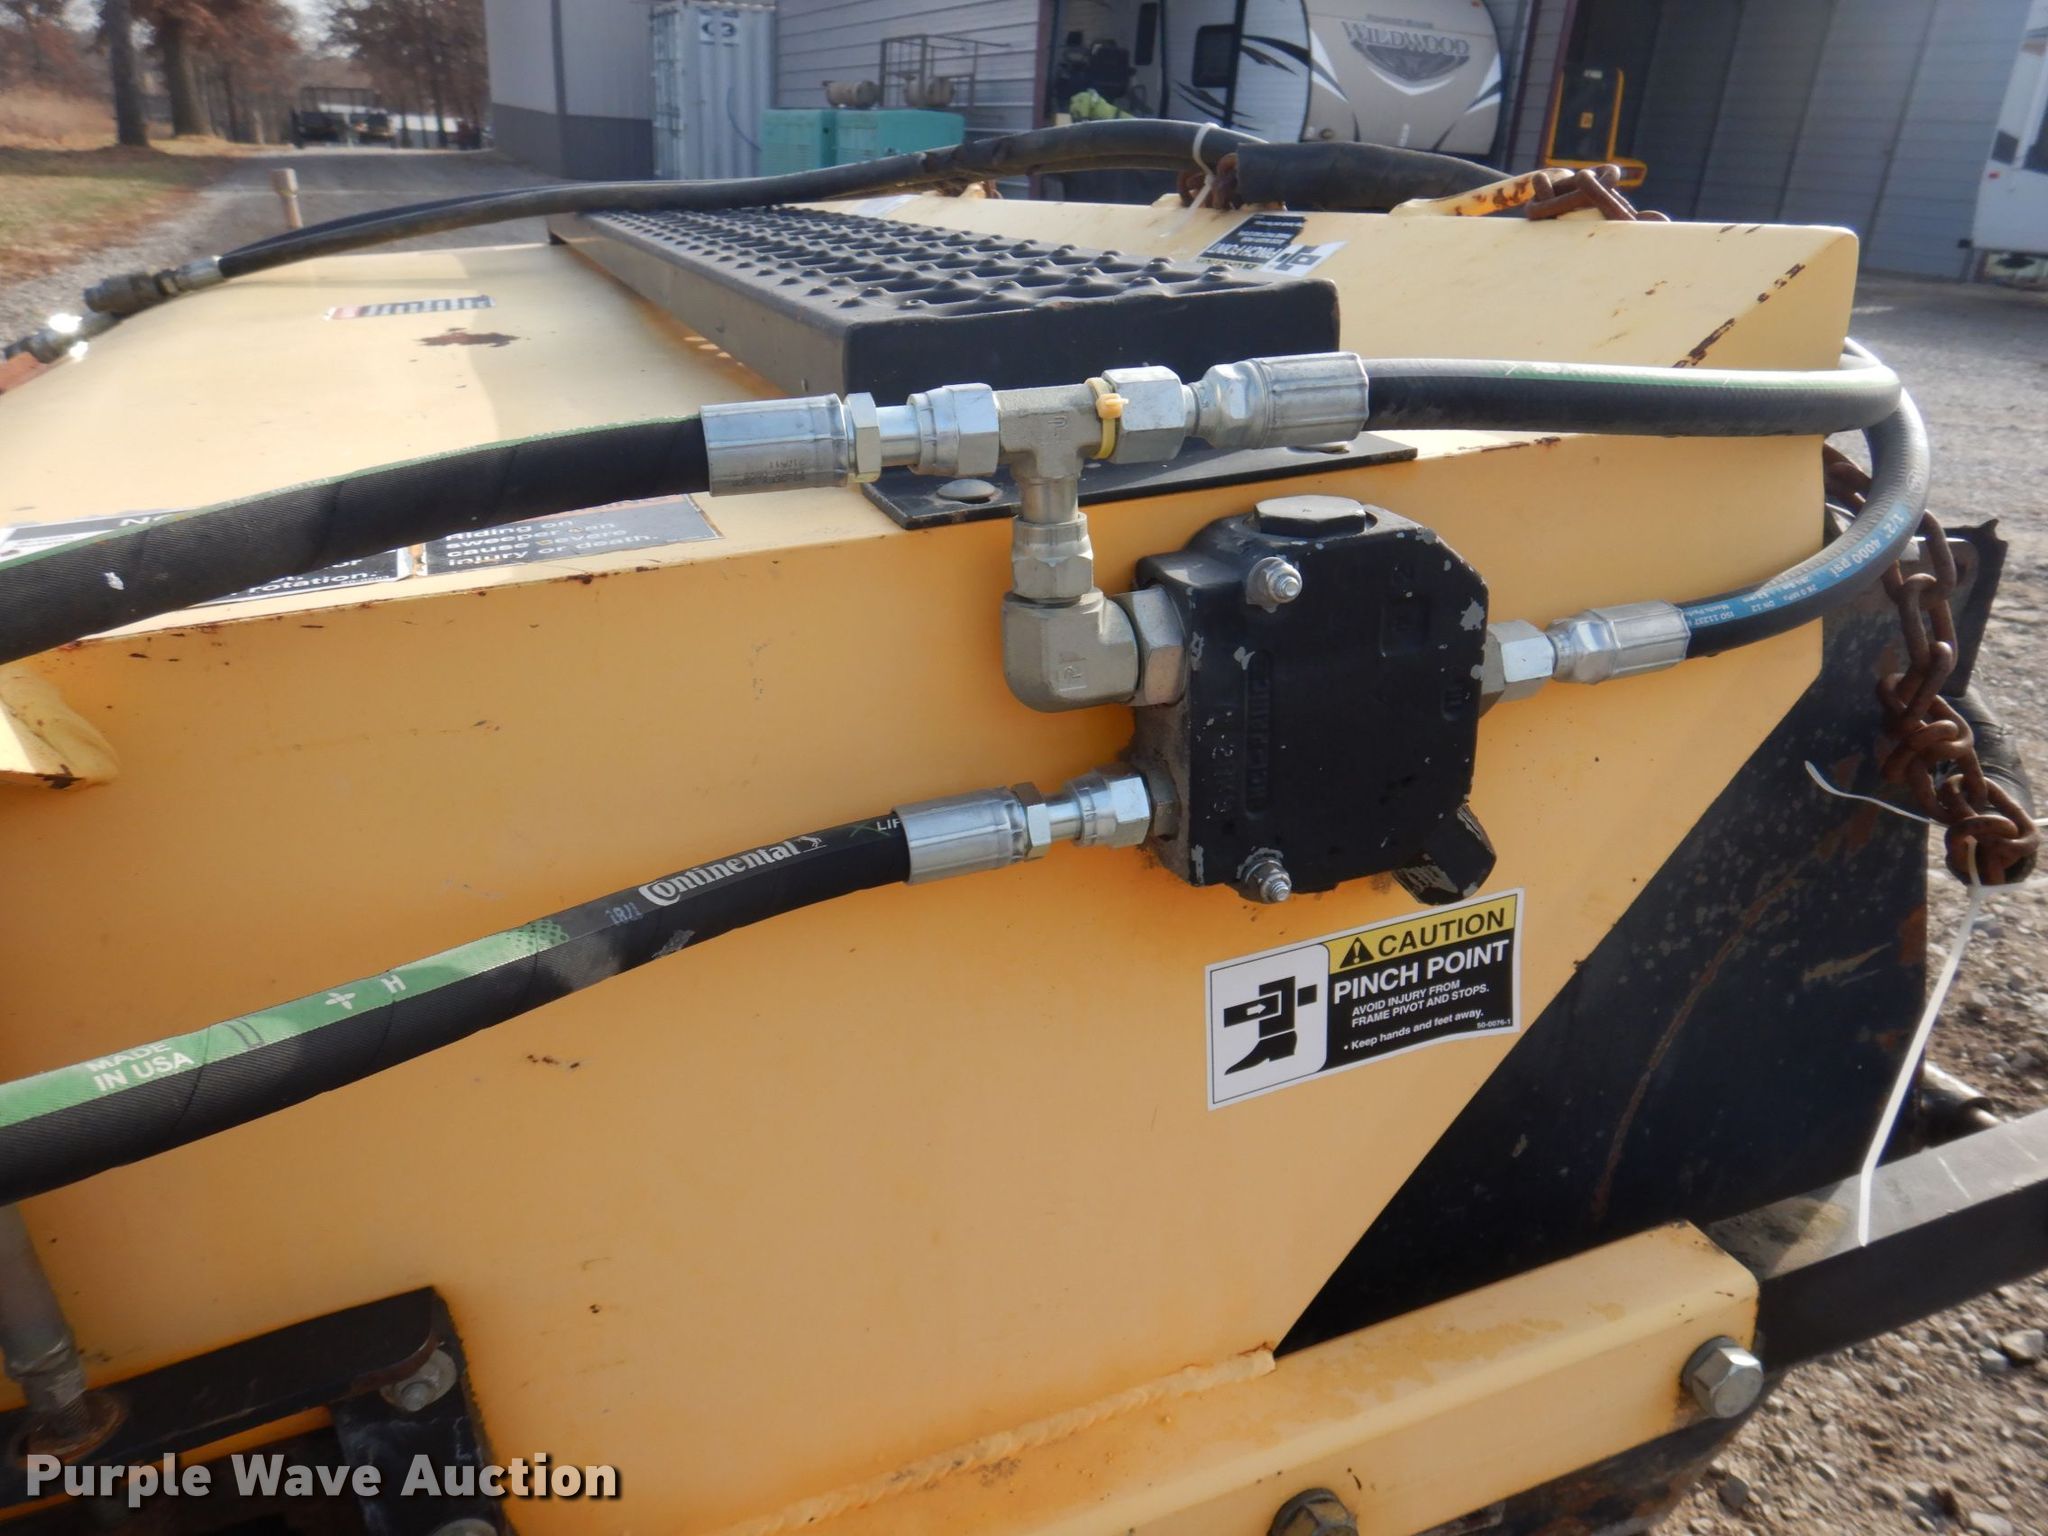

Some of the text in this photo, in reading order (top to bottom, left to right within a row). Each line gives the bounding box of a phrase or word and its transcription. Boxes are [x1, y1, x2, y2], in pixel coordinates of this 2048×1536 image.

[1343, 21, 1470, 55] WILDWOOD
[446, 529, 561, 550] sweeper
[540, 519, 573, 529] on
[446, 541, 530, 558] cause
[448, 550, 529, 567] injury
[538, 544, 569, 555] or
[1851, 538, 1882, 565] 4000
[1829, 556, 1852, 579] psi
[638, 840, 801, 907] Continental
[1378, 907, 1506, 958] CAUTION
[1333, 938, 1511, 1005] PINCH POINT
[1351, 979, 1461, 1018] AVOID INJURY FROM
[1351, 982, 1490, 1028] FRAME PIVOT AND STOPS.
[1350, 1007, 1485, 1051] Keep hands and feet away.
[85, 1041, 172, 1073] MADE
[91, 1051, 195, 1092] IN USA
